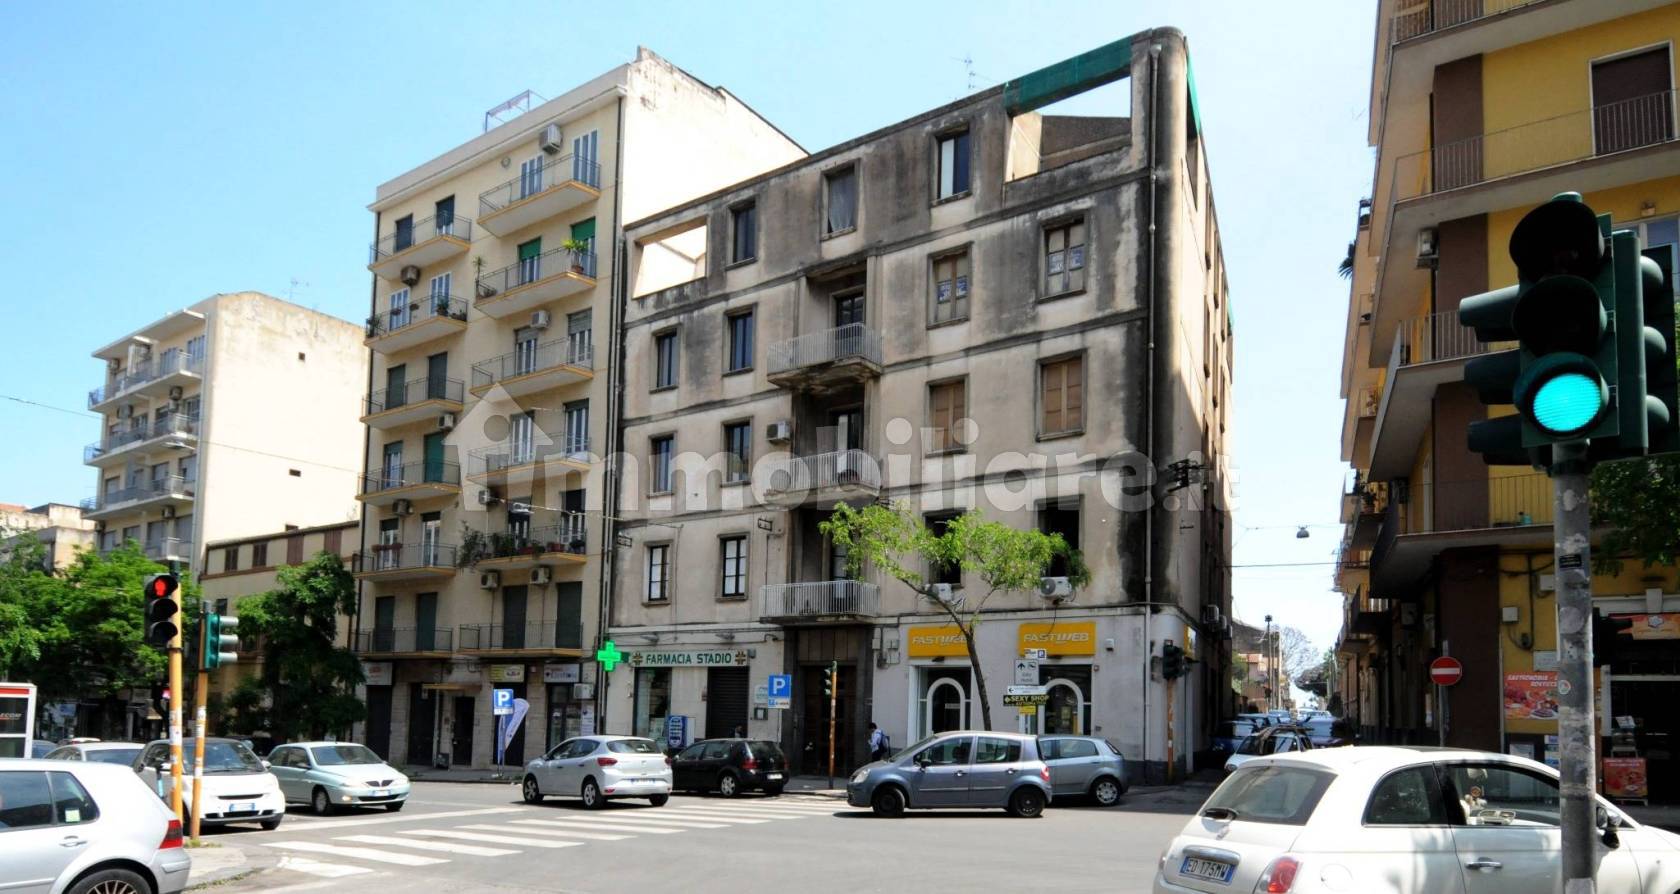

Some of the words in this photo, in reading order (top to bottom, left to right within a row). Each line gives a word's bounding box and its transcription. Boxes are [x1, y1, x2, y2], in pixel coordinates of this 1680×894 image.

[1023, 632, 1089, 644] FASTWEB
[646, 654, 692, 665] FARMACIA
[697, 653, 732, 664] STADIO
[773, 677, 786, 695] P
[498, 691, 510, 706] P
